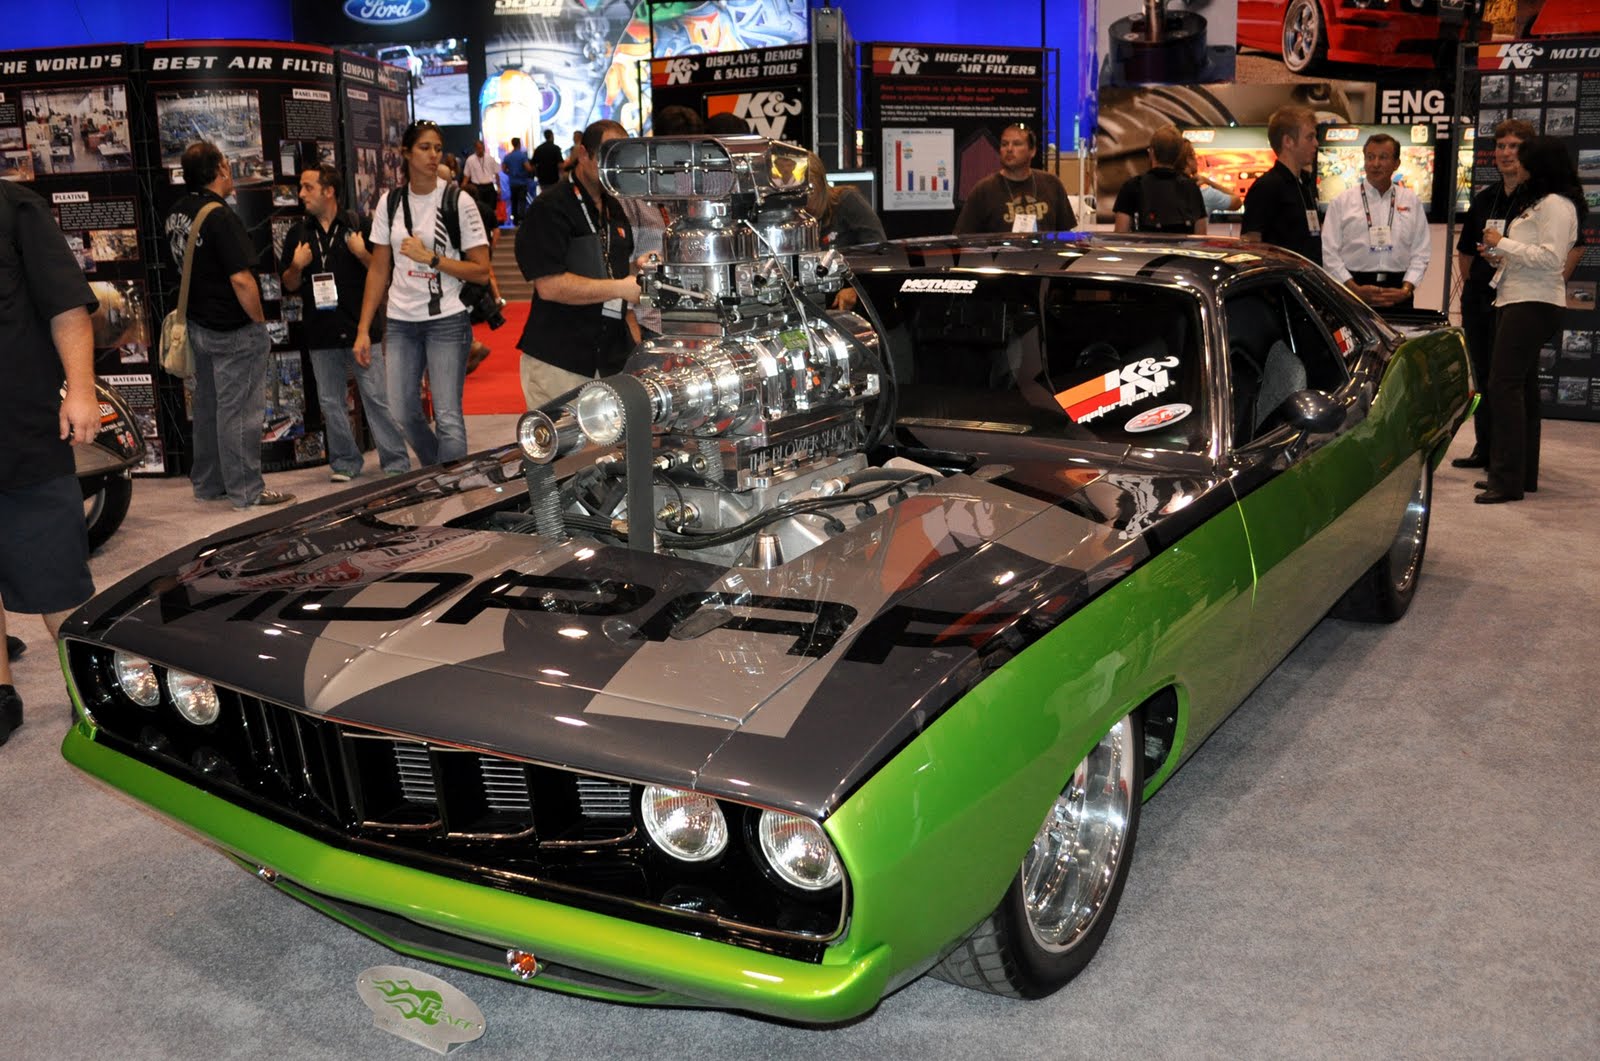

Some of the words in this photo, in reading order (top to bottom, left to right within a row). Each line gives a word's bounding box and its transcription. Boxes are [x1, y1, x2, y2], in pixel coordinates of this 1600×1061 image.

[360, 0, 413, 18] Ford
[0, 61, 27, 74] HE
[35, 54, 122, 72] WORLD'S
[152, 56, 218, 71] BEST
[227, 56, 273, 70] AIR
[282, 57, 334, 75] FILTER
[706, 52, 760, 67] DISPLAYS,
[764, 48, 803, 62] DEMOS
[934, 52, 1009, 64] HIGH-FLOW
[342, 62, 375, 80] COMPANY
[714, 70, 722, 80] &
[725, 66, 758, 79] SALES
[763, 63, 797, 75] TOOLS
[957, 64, 981, 74] AIR
[985, 64, 1037, 75] FILTERS
[1381, 90, 1445, 114] ENG
[54, 193, 87, 201] PLEATING
[1003, 201, 1048, 222] Jeep
[900, 279, 978, 290] MOTHERS
[772, 435, 819, 464] BLOWER
[821, 424, 851, 447] SHOP
